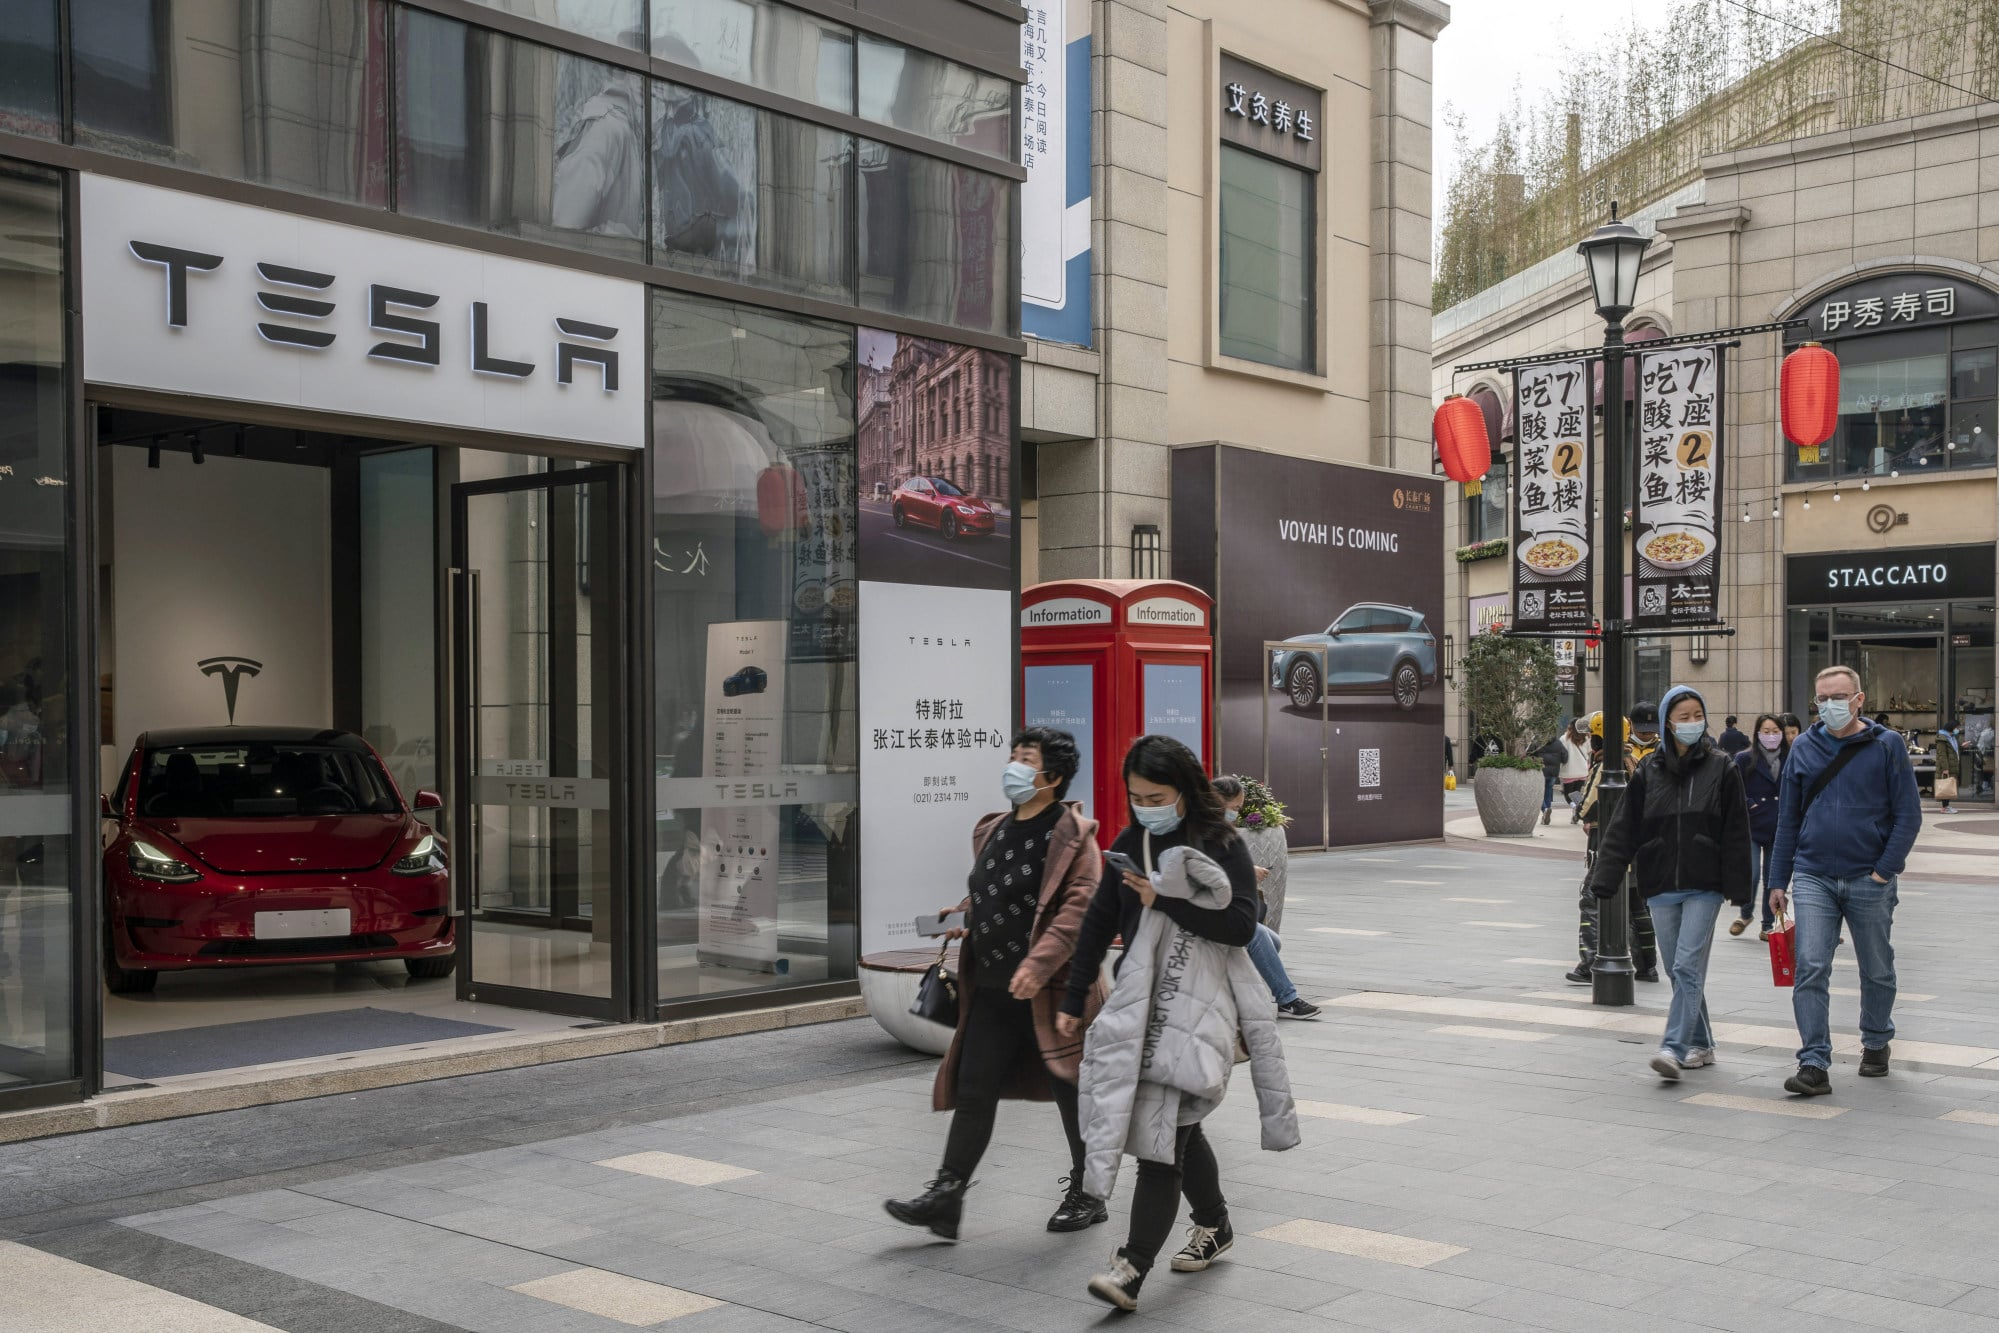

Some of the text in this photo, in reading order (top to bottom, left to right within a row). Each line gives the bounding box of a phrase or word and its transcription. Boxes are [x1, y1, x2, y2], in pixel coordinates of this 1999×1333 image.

[1227, 83, 1313, 140] 艾灸养生
[129, 240, 619, 391] TESLA
[1821, 287, 1955, 331] 伊秀寿司
[1279, 519, 1398, 553] VOYAH IS COMING
[1829, 564, 1947, 588] STACCATO
[1549, 589, 1586, 604] 太二
[1672, 584, 1711, 599] 太二
[1030, 607, 1101, 623] Information
[1137, 606, 1196, 622] Information
[909, 637, 971, 646] TESLA
[916, 699, 964, 720] 特斯拉
[873, 728, 1004, 750] 张江长泰体验中心
[923, 776, 957, 787] 即刻试驾
[505, 783, 575, 800] TESLA
[715, 782, 798, 799] TESLA
[913, 792, 969, 804] (021) 2314 7119
[1157, 970, 1182, 1001] OUR
